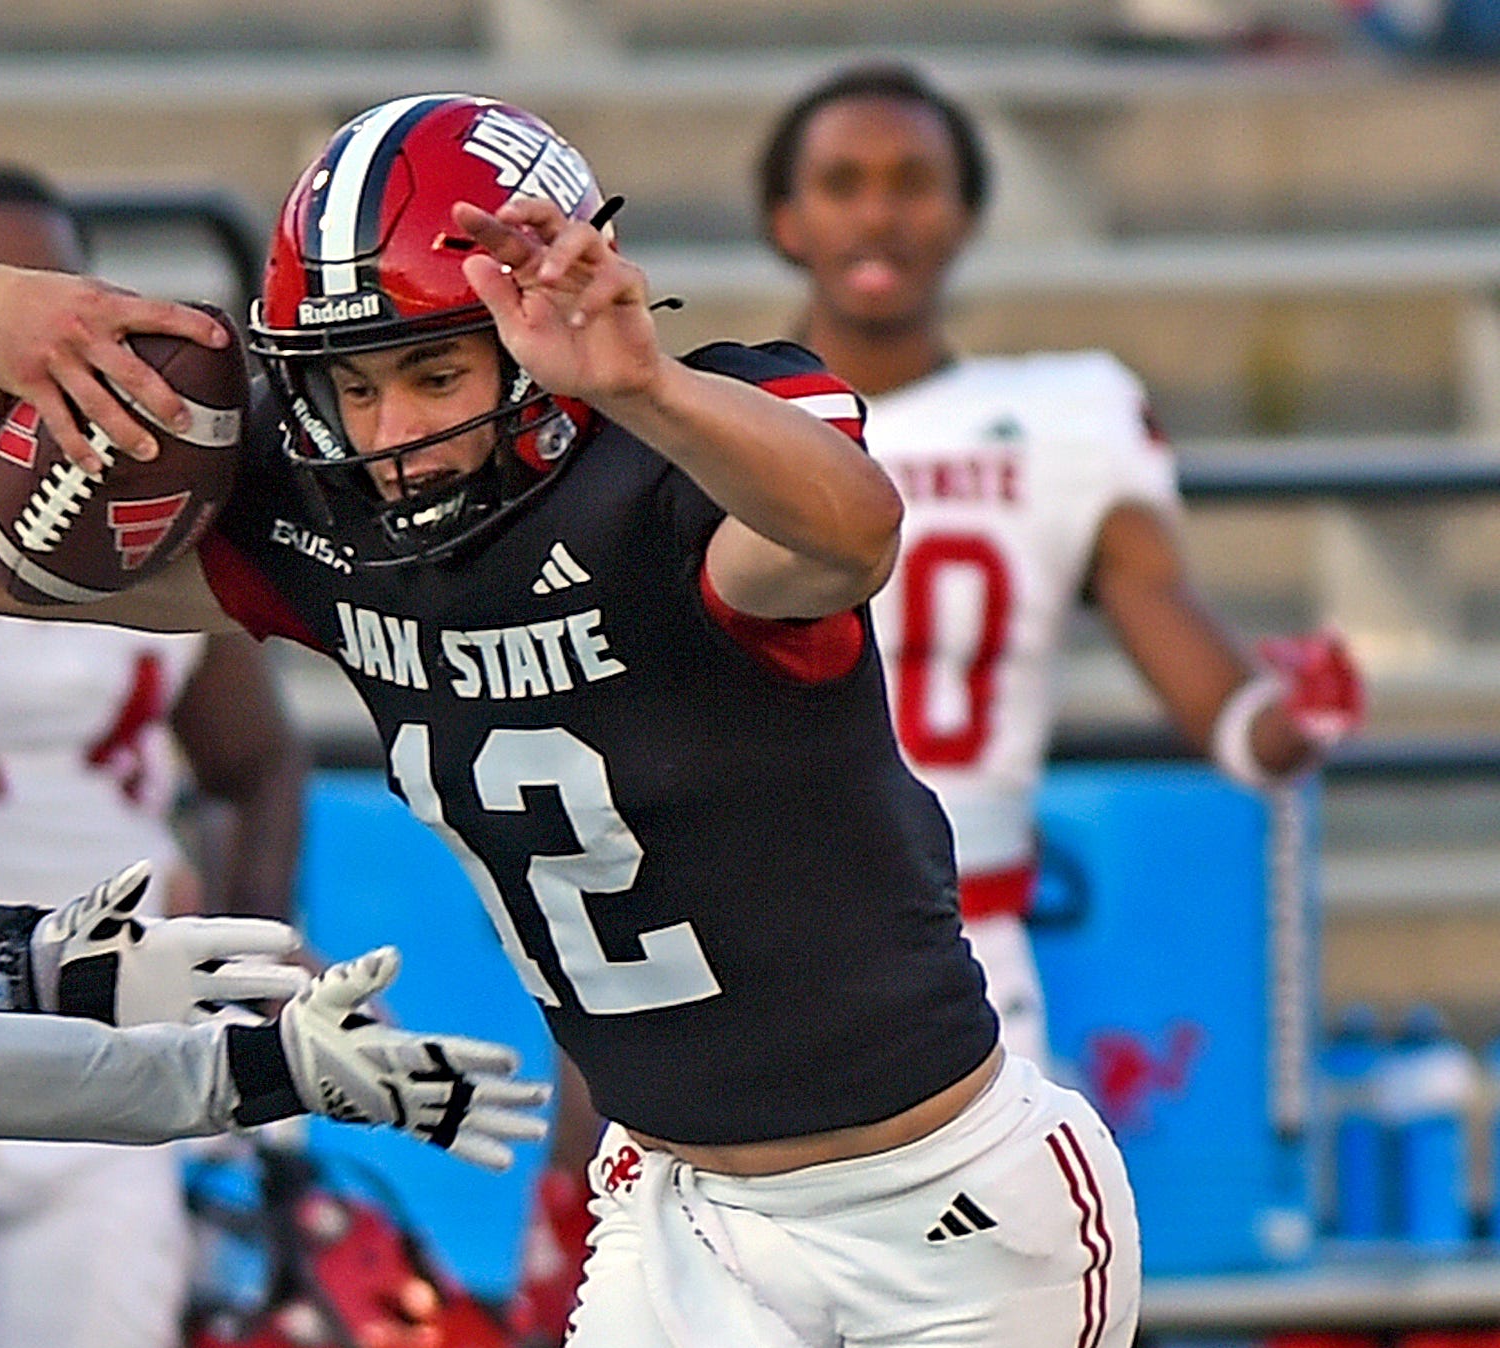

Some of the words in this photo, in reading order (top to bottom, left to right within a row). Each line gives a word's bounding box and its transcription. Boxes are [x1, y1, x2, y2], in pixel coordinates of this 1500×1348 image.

[462, 108, 548, 187] JAX
[299, 294, 379, 326] Riddell
[292, 397, 346, 460] Riddell
[335, 601, 430, 691] JAX
[439, 607, 628, 700] STATE
[389, 722, 723, 1016] 12
